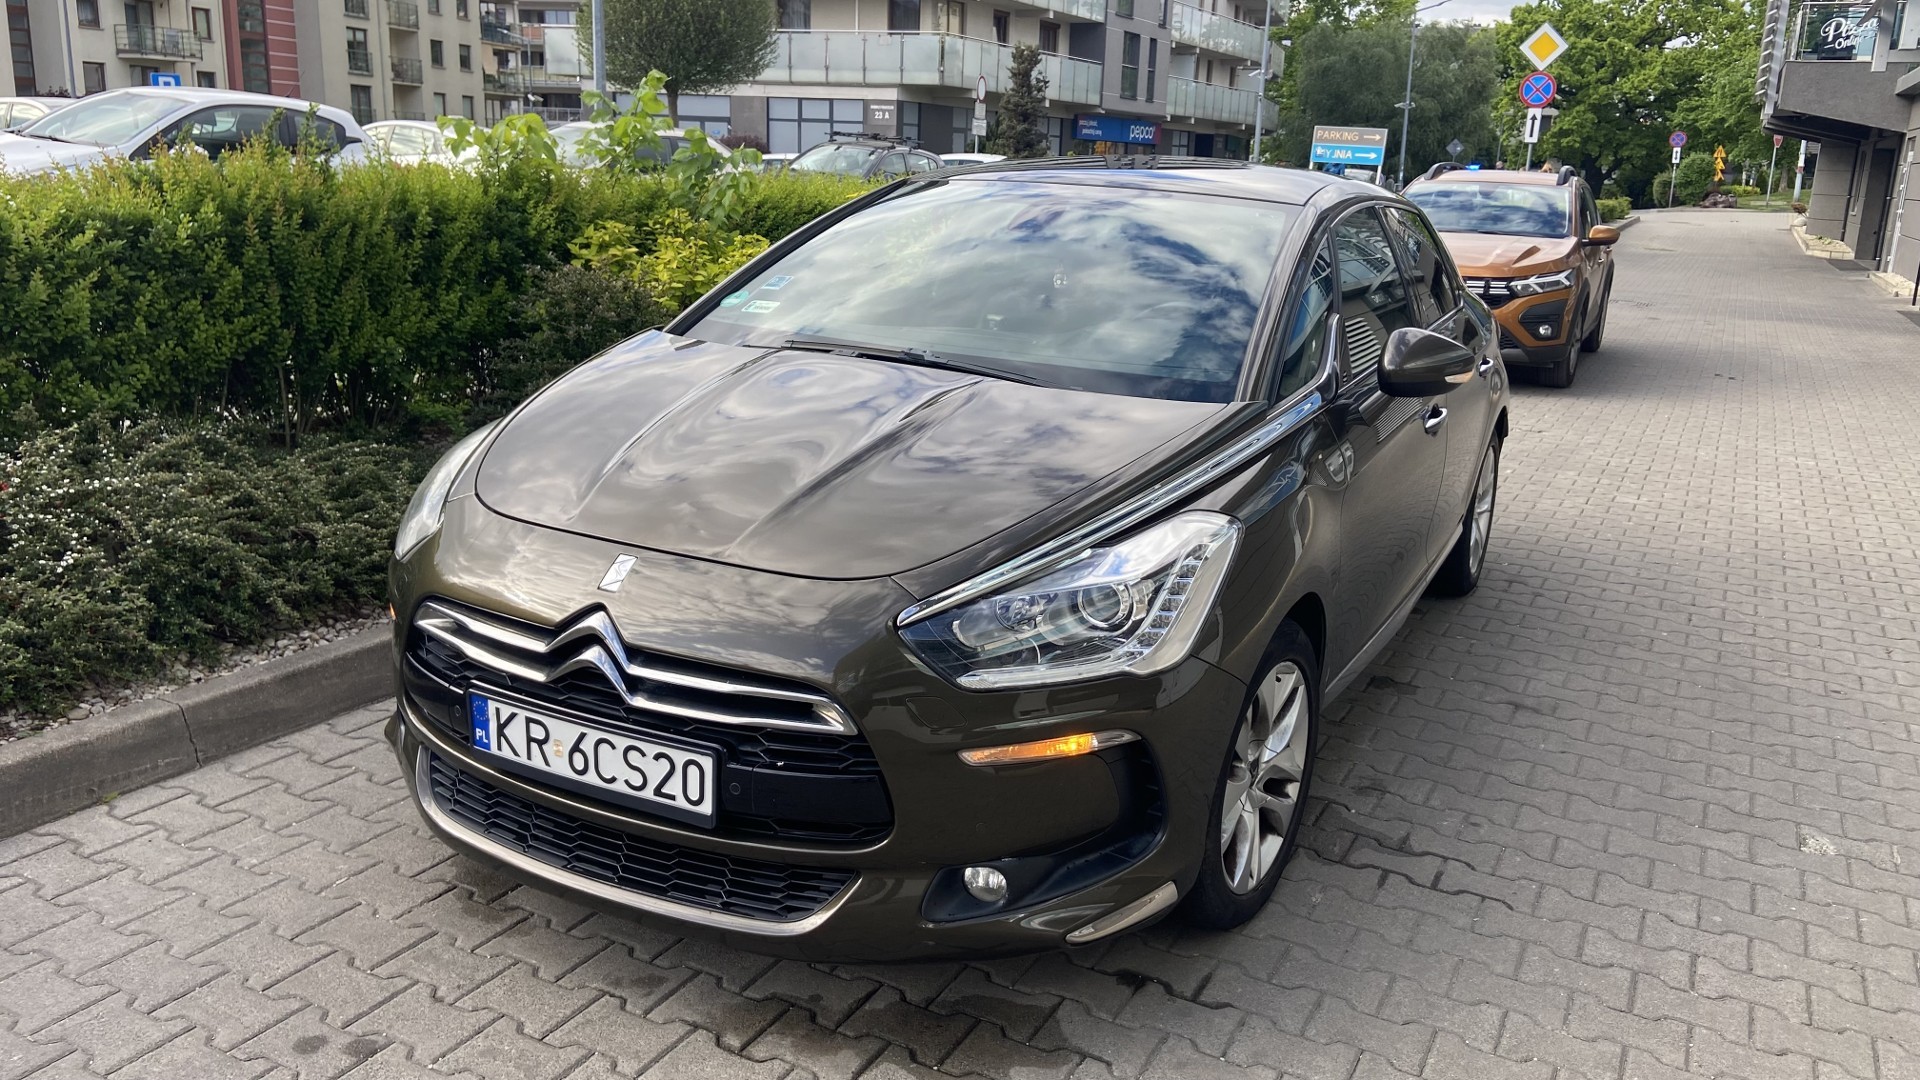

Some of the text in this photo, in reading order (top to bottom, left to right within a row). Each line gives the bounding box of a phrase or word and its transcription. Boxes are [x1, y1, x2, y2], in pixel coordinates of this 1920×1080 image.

[1129, 125, 1154, 141] pepco
[1316, 130, 1359, 141] PARKING
[475, 728, 489, 744] PL
[494, 706, 706, 807] KR 6CS20
